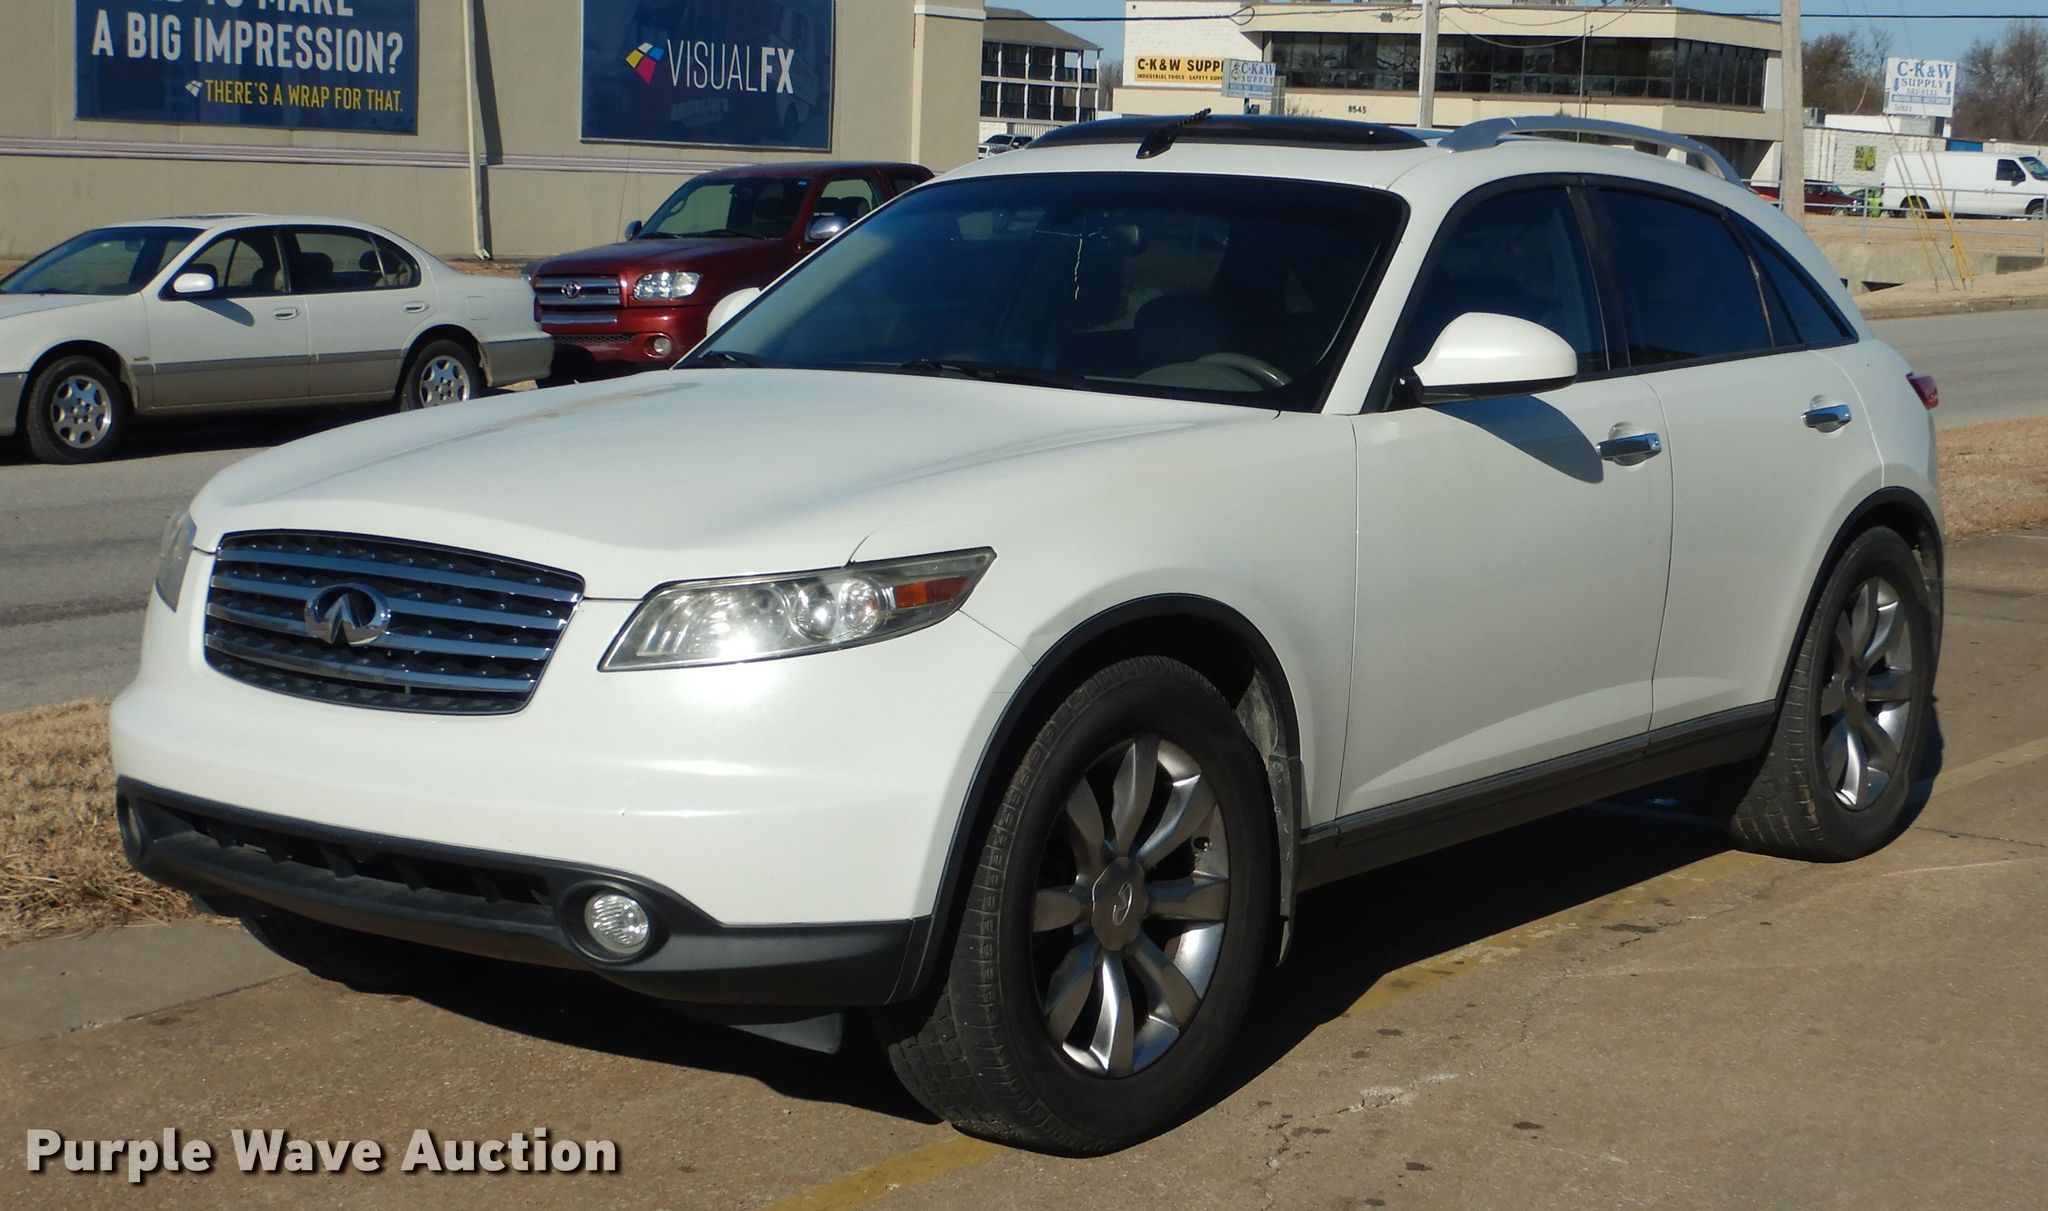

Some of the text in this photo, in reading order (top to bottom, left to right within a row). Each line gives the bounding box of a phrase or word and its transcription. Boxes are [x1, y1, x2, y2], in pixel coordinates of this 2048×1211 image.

[92, 9, 403, 74] A BIG IMPRESSION?
[1242, 76, 1273, 85] SUPPLY
[1901, 78, 1944, 89] SUPPLY
[205, 79, 403, 113] THERE'S A WRAP FOR THAT.
